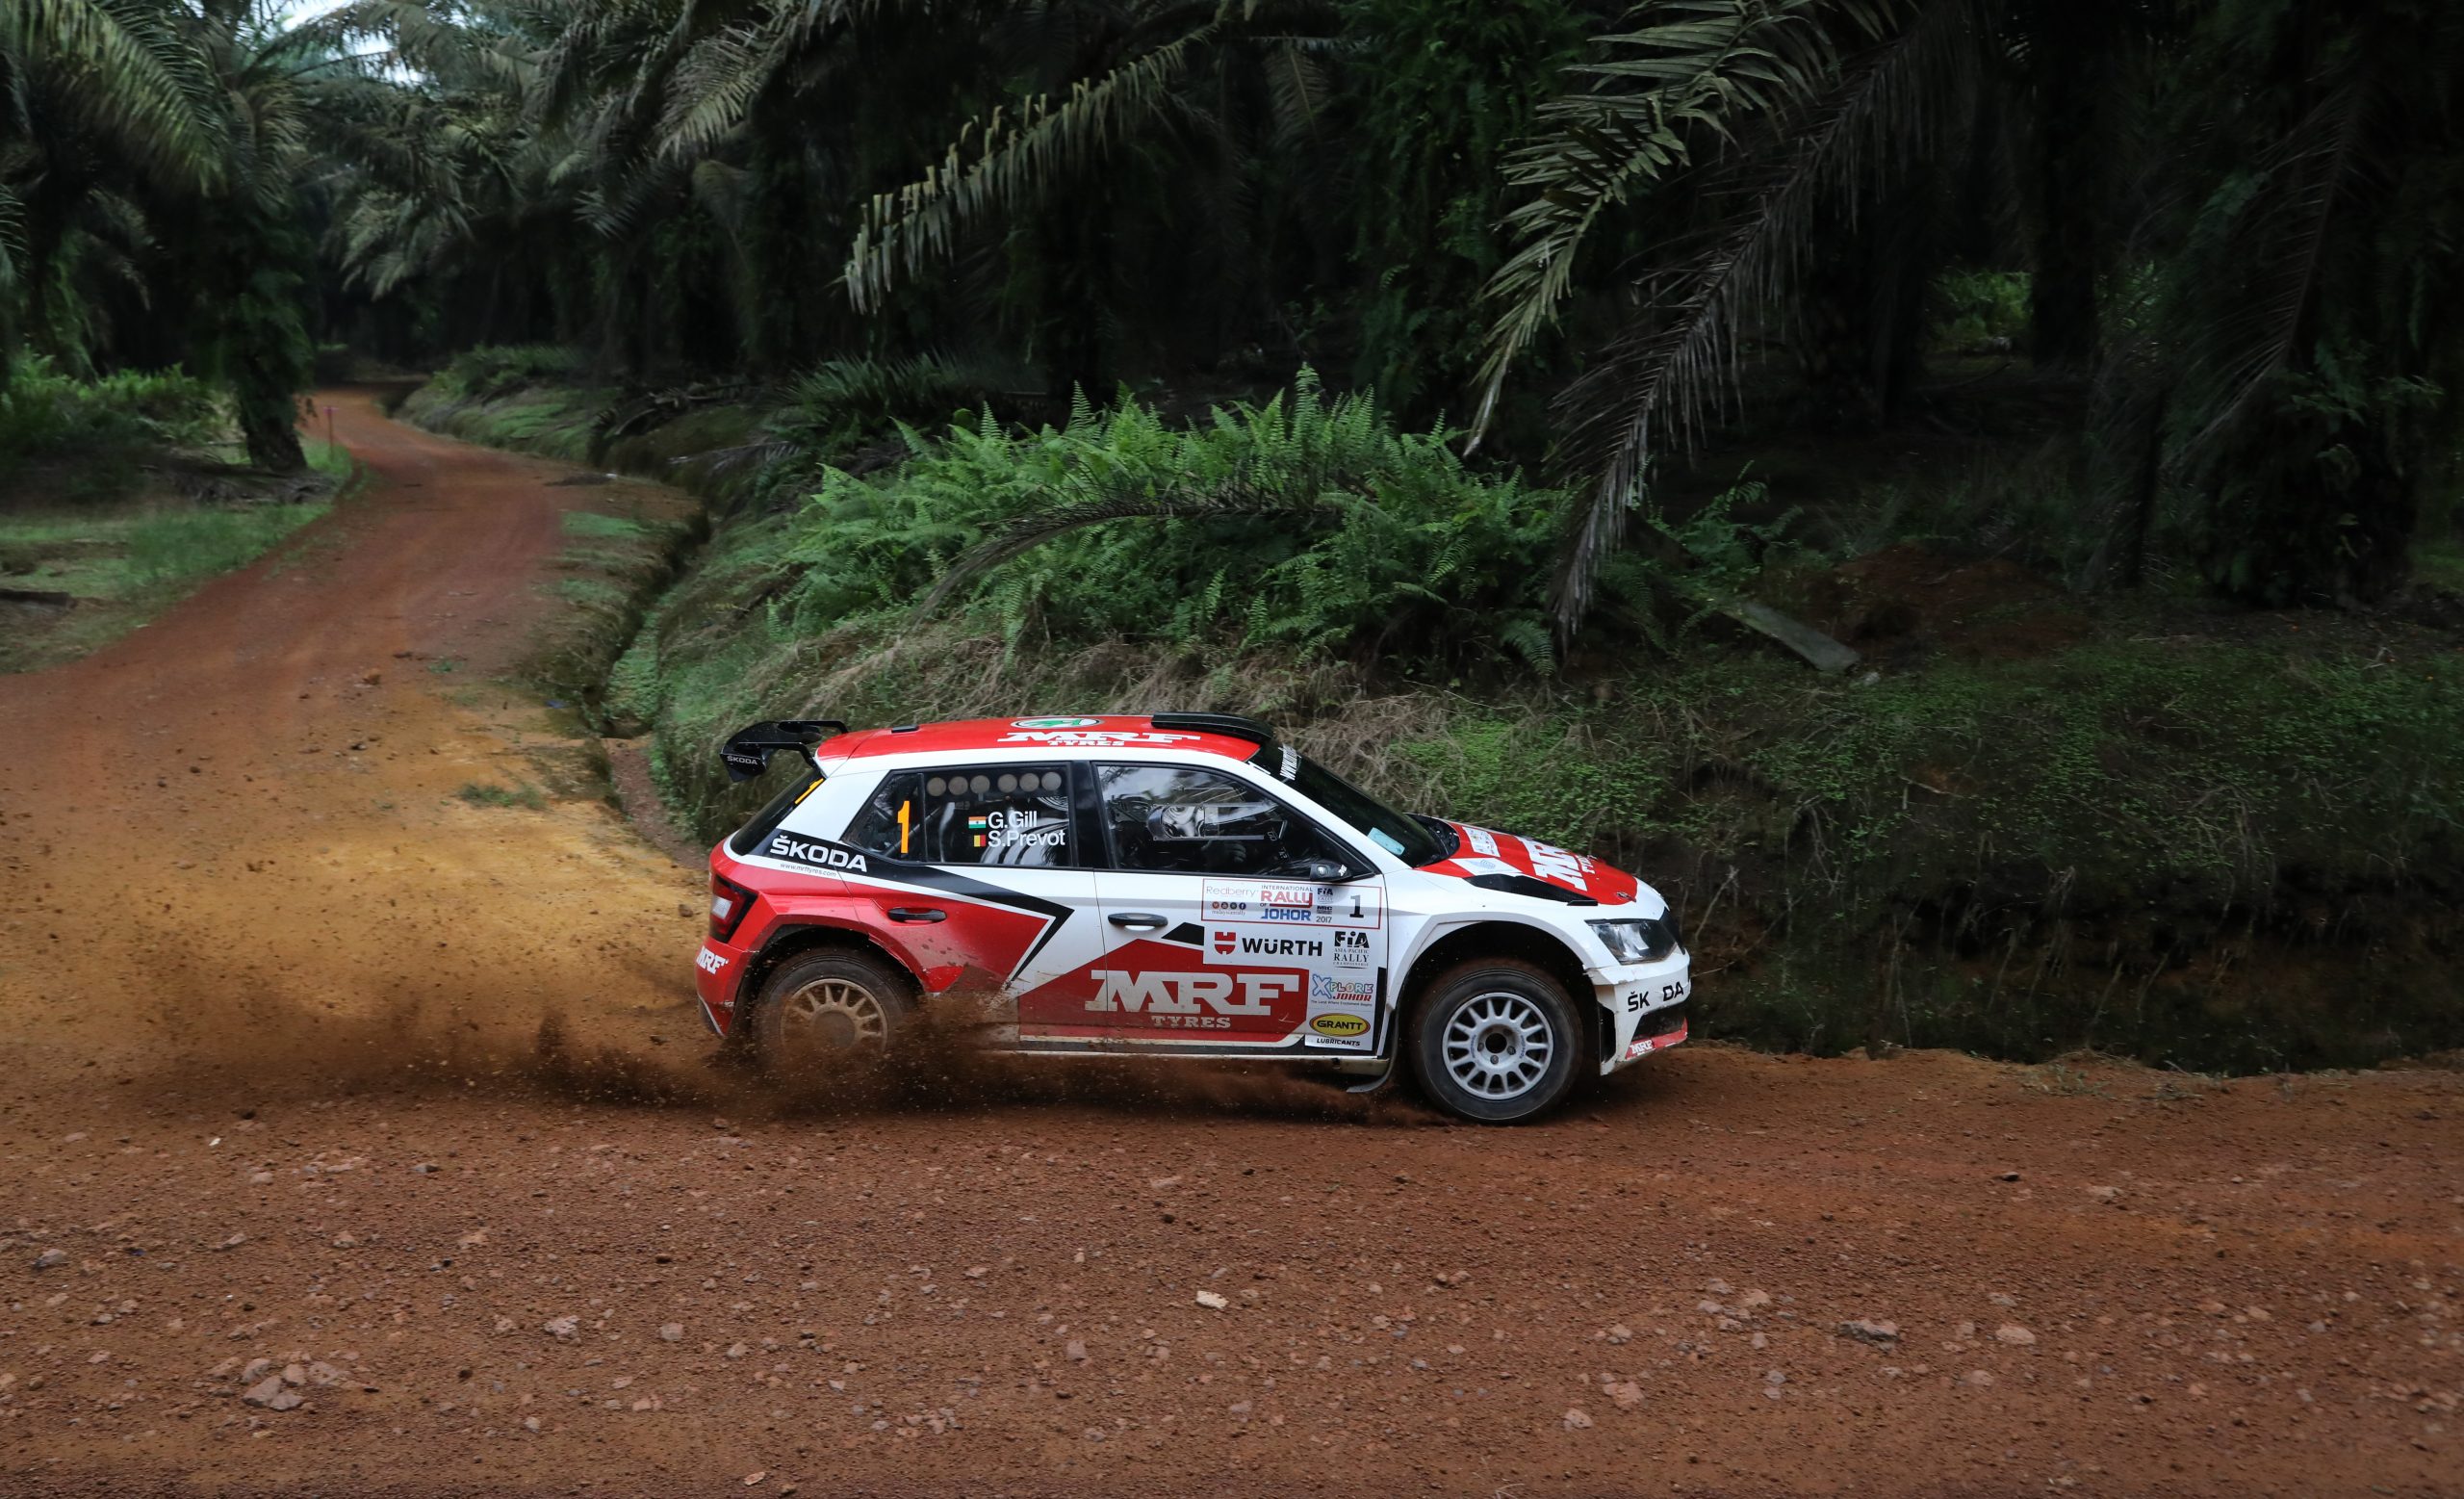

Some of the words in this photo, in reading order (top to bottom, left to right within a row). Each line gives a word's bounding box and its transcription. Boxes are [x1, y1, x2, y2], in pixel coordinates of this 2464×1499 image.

[997, 731, 1201, 743] MRF
[727, 755, 758, 765] ŠKODA
[988, 811, 1038, 829] G.Gill
[897, 800, 911, 854] 1
[988, 830, 1066, 848] S.Prevot
[770, 834, 868, 873] ŠKODA
[1206, 885, 1255, 898] Redberry
[1261, 884, 1314, 892] INTERNATIONAL
[1260, 891, 1314, 907] RALLY
[1349, 894, 1365, 918] 1
[1260, 908, 1312, 921] JOHOR
[1333, 953, 1370, 963] RALLY
[1085, 969, 1299, 1016] MRF
[1332, 993, 1373, 1001] JOHOR
[1151, 1016, 1232, 1028] TYRES
[1317, 1020, 1363, 1031] GRANTT
[1317, 1038, 1361, 1047] LUBRICANTS
[1630, 1039, 1654, 1054] MRF
